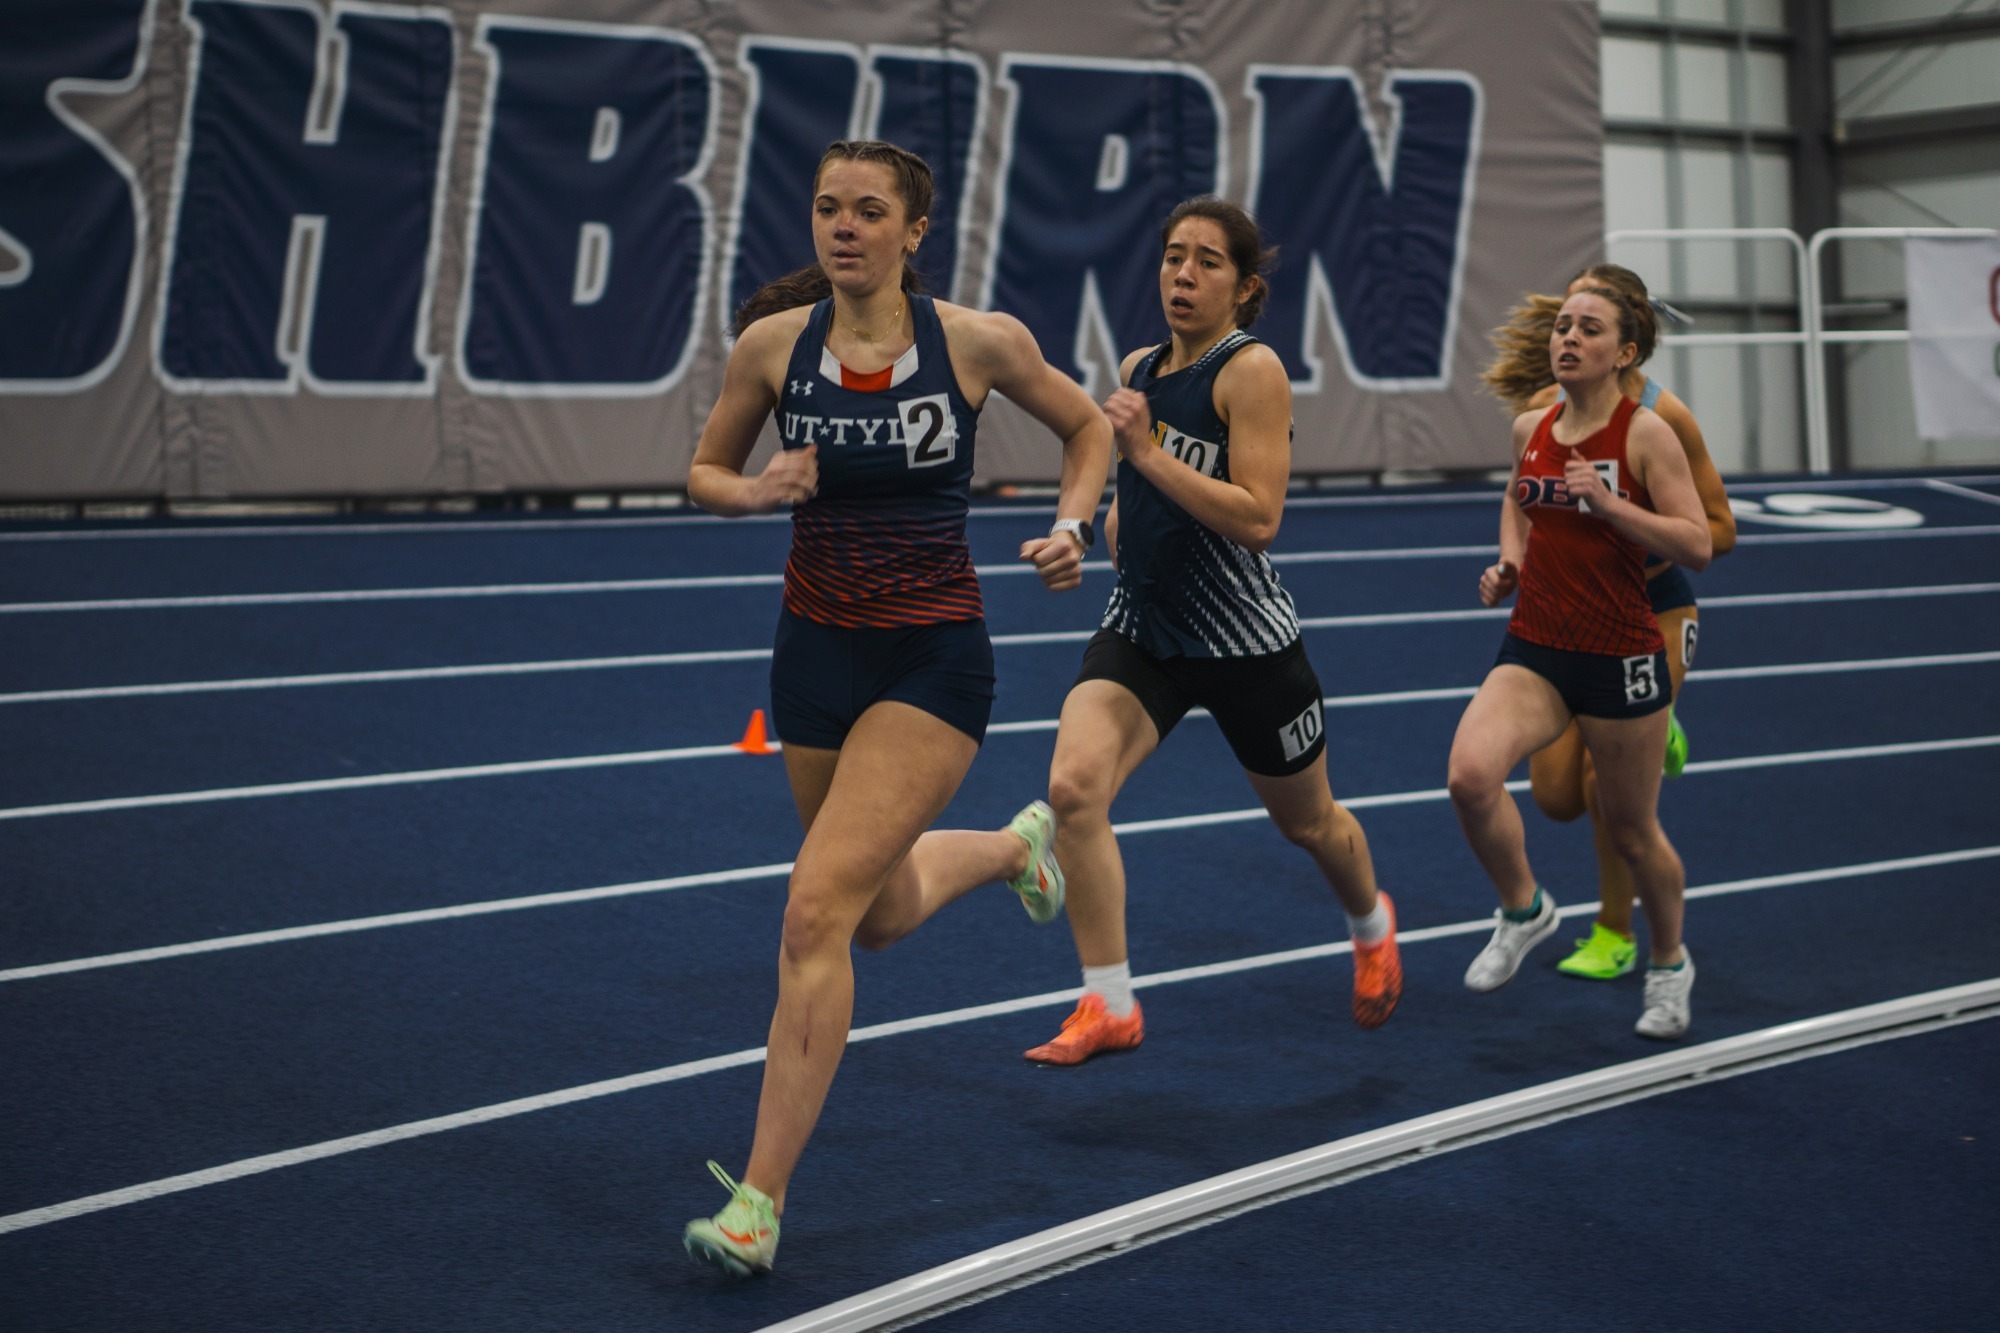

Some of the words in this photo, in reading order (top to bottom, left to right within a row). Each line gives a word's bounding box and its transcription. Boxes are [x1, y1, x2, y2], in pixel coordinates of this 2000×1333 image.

[829, 415, 960, 445] TYL
[907, 401, 949, 464] 2
[1171, 435, 1206, 473] 10
[1685, 623, 1697, 664] 6
[1630, 656, 1652, 699] 5
[1288, 709, 1317, 752] 10
